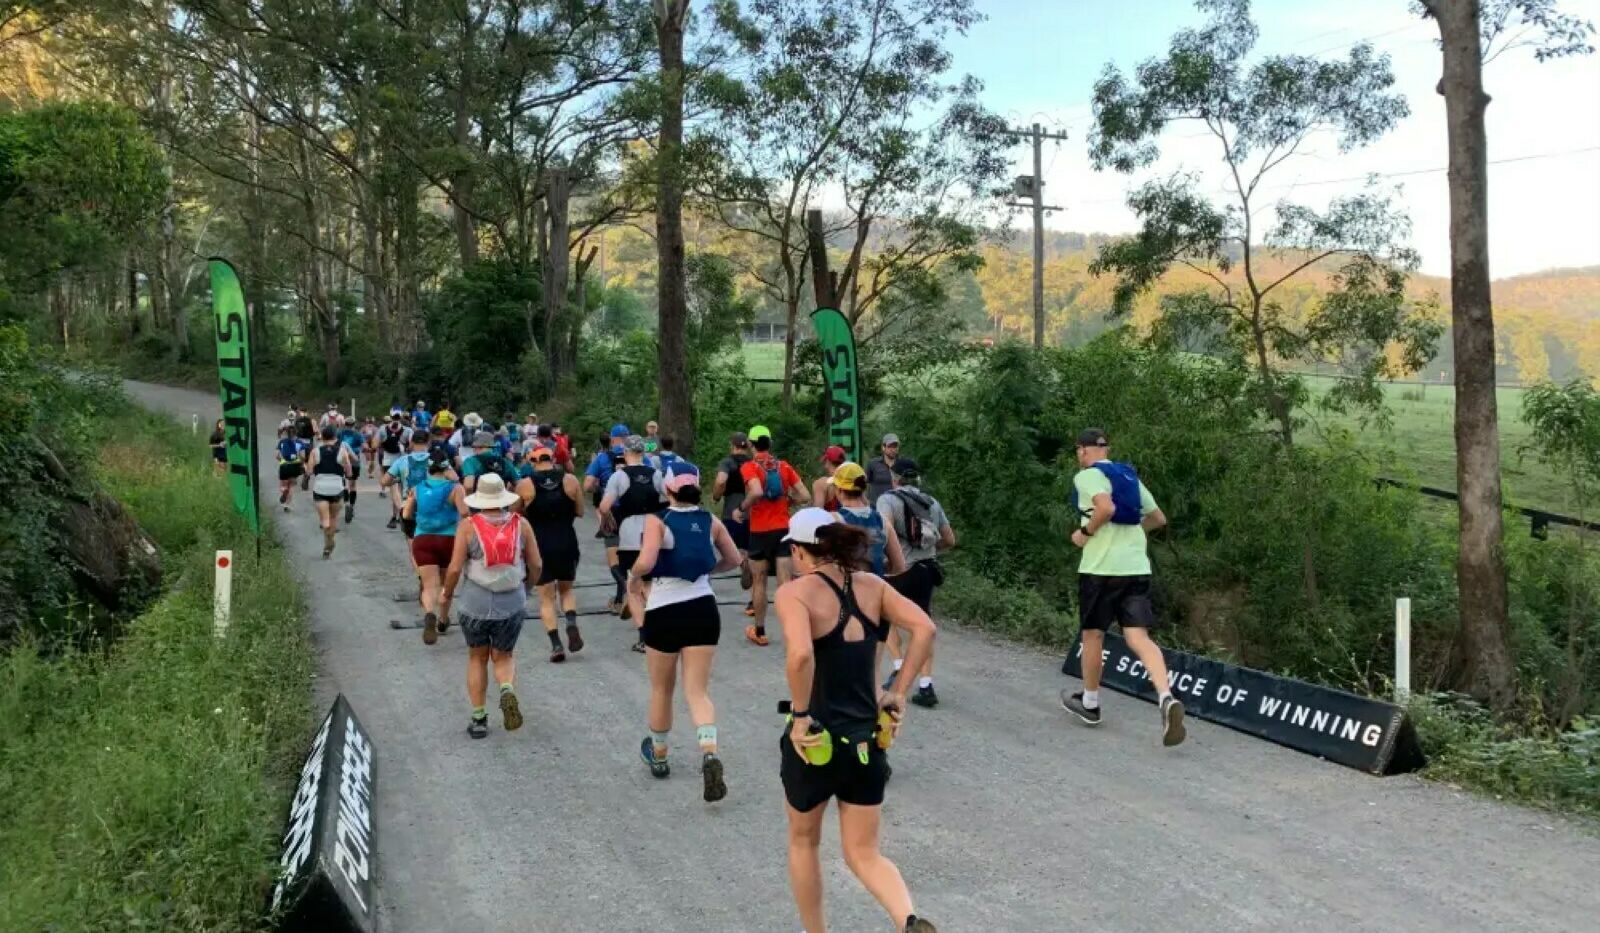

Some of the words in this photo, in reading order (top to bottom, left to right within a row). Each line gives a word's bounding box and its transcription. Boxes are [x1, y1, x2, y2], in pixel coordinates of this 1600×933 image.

[216, 311, 250, 487] START
[825, 344, 856, 461] STAR
[1076, 642, 1111, 667] TE
[1115, 655, 1208, 696] SCINCE
[1216, 684, 1248, 707] OF
[1259, 695, 1384, 747] WINNING
[334, 715, 372, 912] POWERADE
